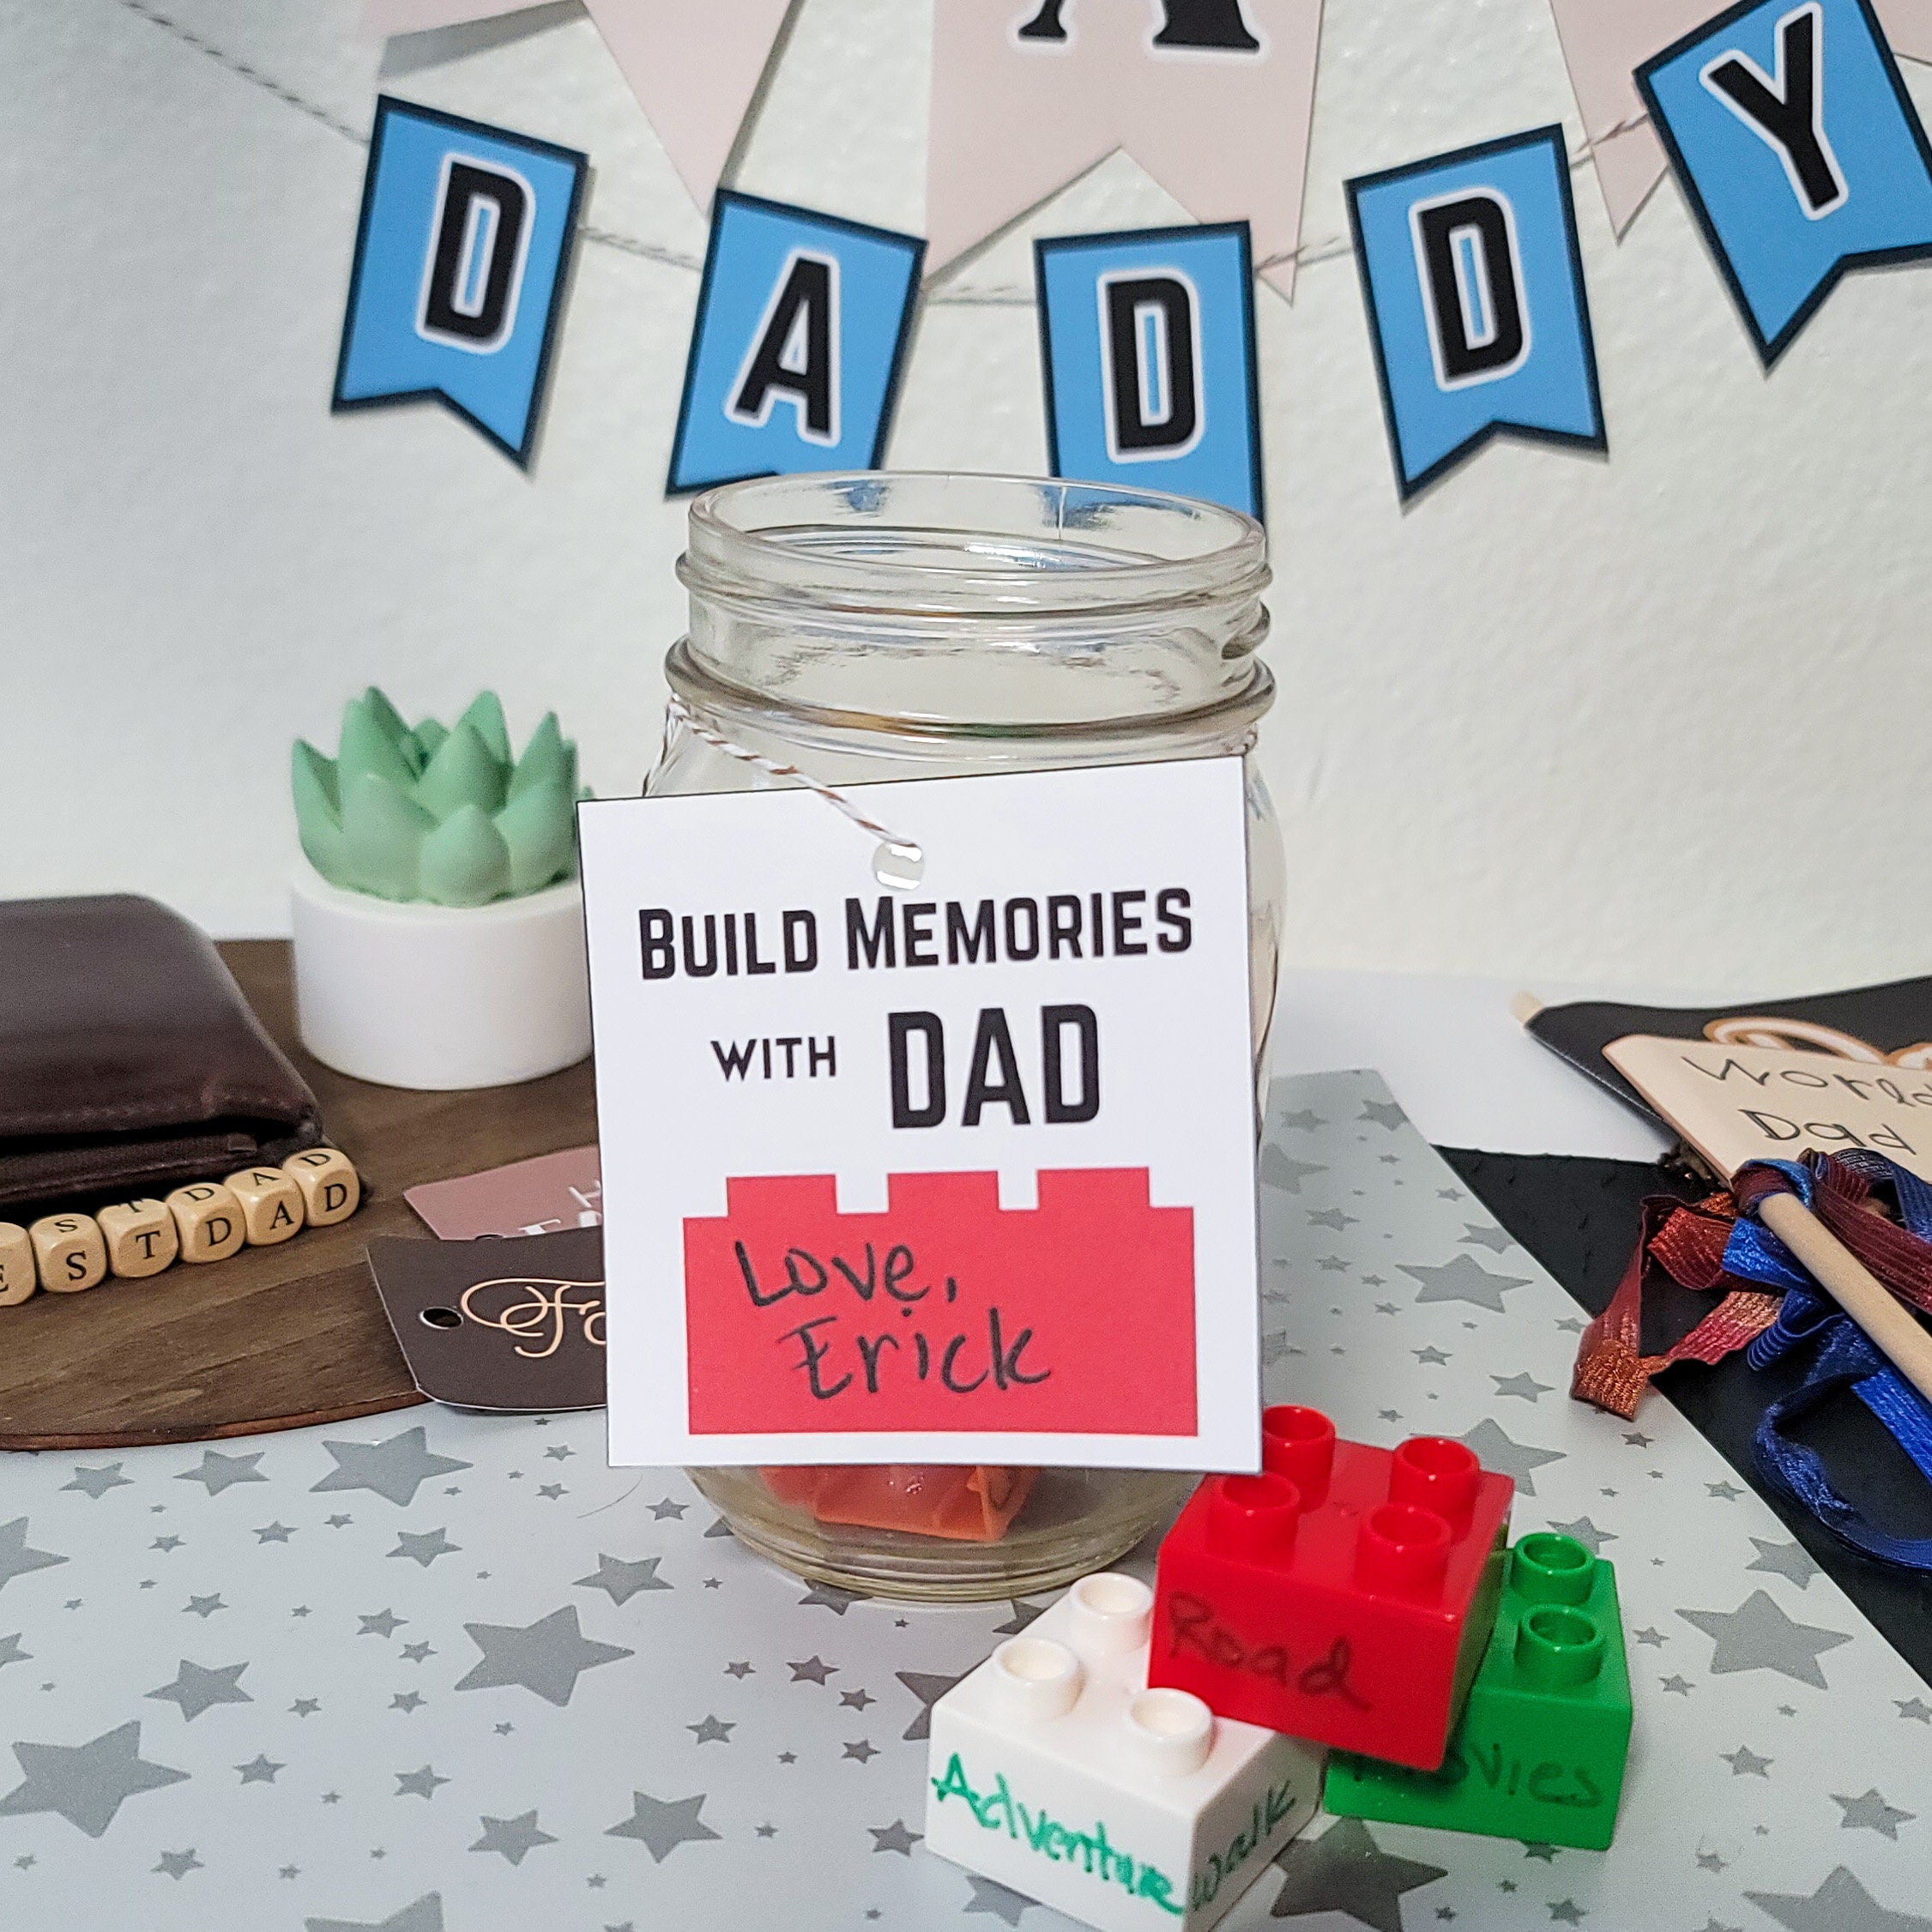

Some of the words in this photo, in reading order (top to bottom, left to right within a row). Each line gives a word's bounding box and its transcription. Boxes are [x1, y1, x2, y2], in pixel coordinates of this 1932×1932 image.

[638, 908, 818, 981] BUILD
[845, 887, 1192, 970] MEMORIES
[888, 1004, 1100, 1129] DAD
[1737, 1108, 1917, 1156] Dad
[734, 1241, 957, 1307] Love,
[777, 1307, 1052, 1400] Erick
[1167, 1591, 1371, 1712] Road
